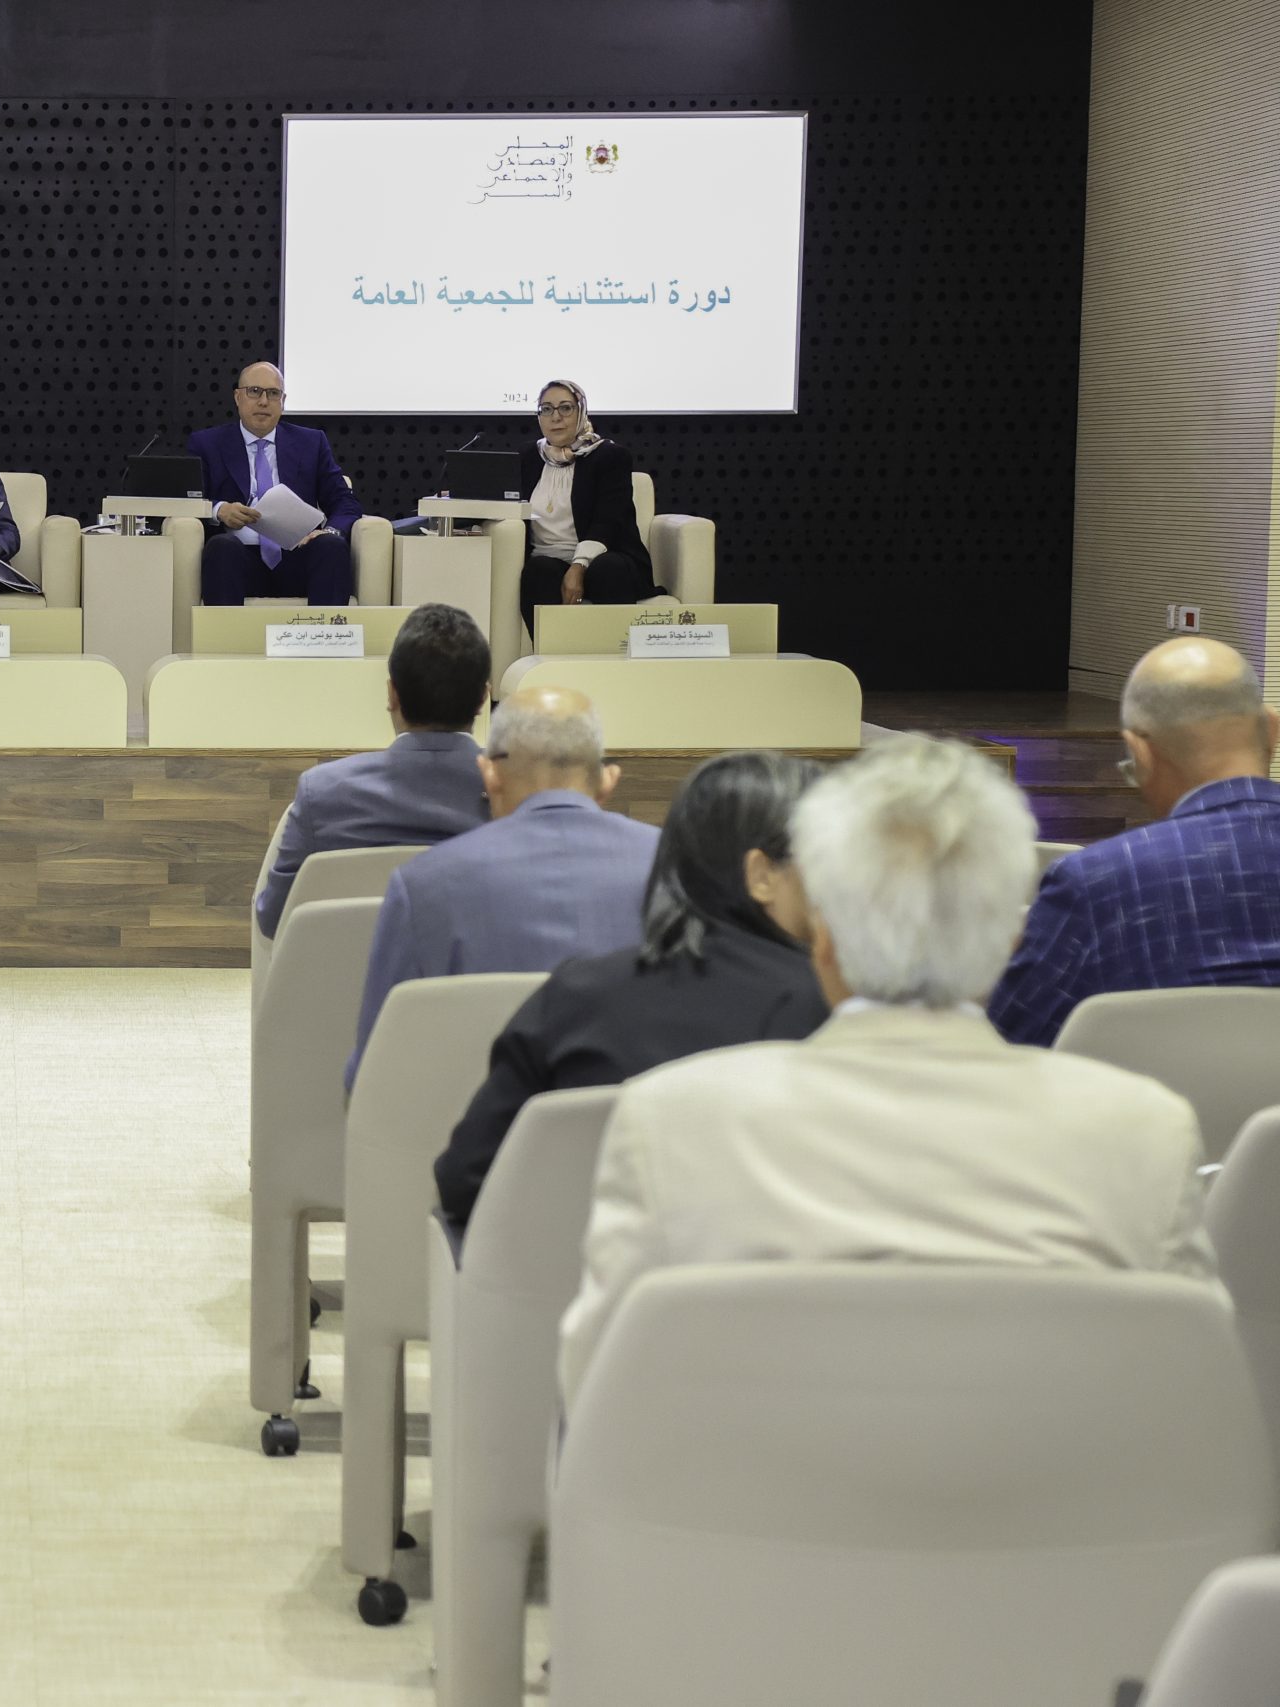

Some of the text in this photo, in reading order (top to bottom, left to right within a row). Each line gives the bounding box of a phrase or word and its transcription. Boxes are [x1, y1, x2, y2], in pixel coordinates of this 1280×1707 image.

[352, 275, 425, 304] العامة
[436, 275, 534, 312] للجمعية
[669, 279, 731, 312] دورة
[502, 393, 528, 403] 2024
